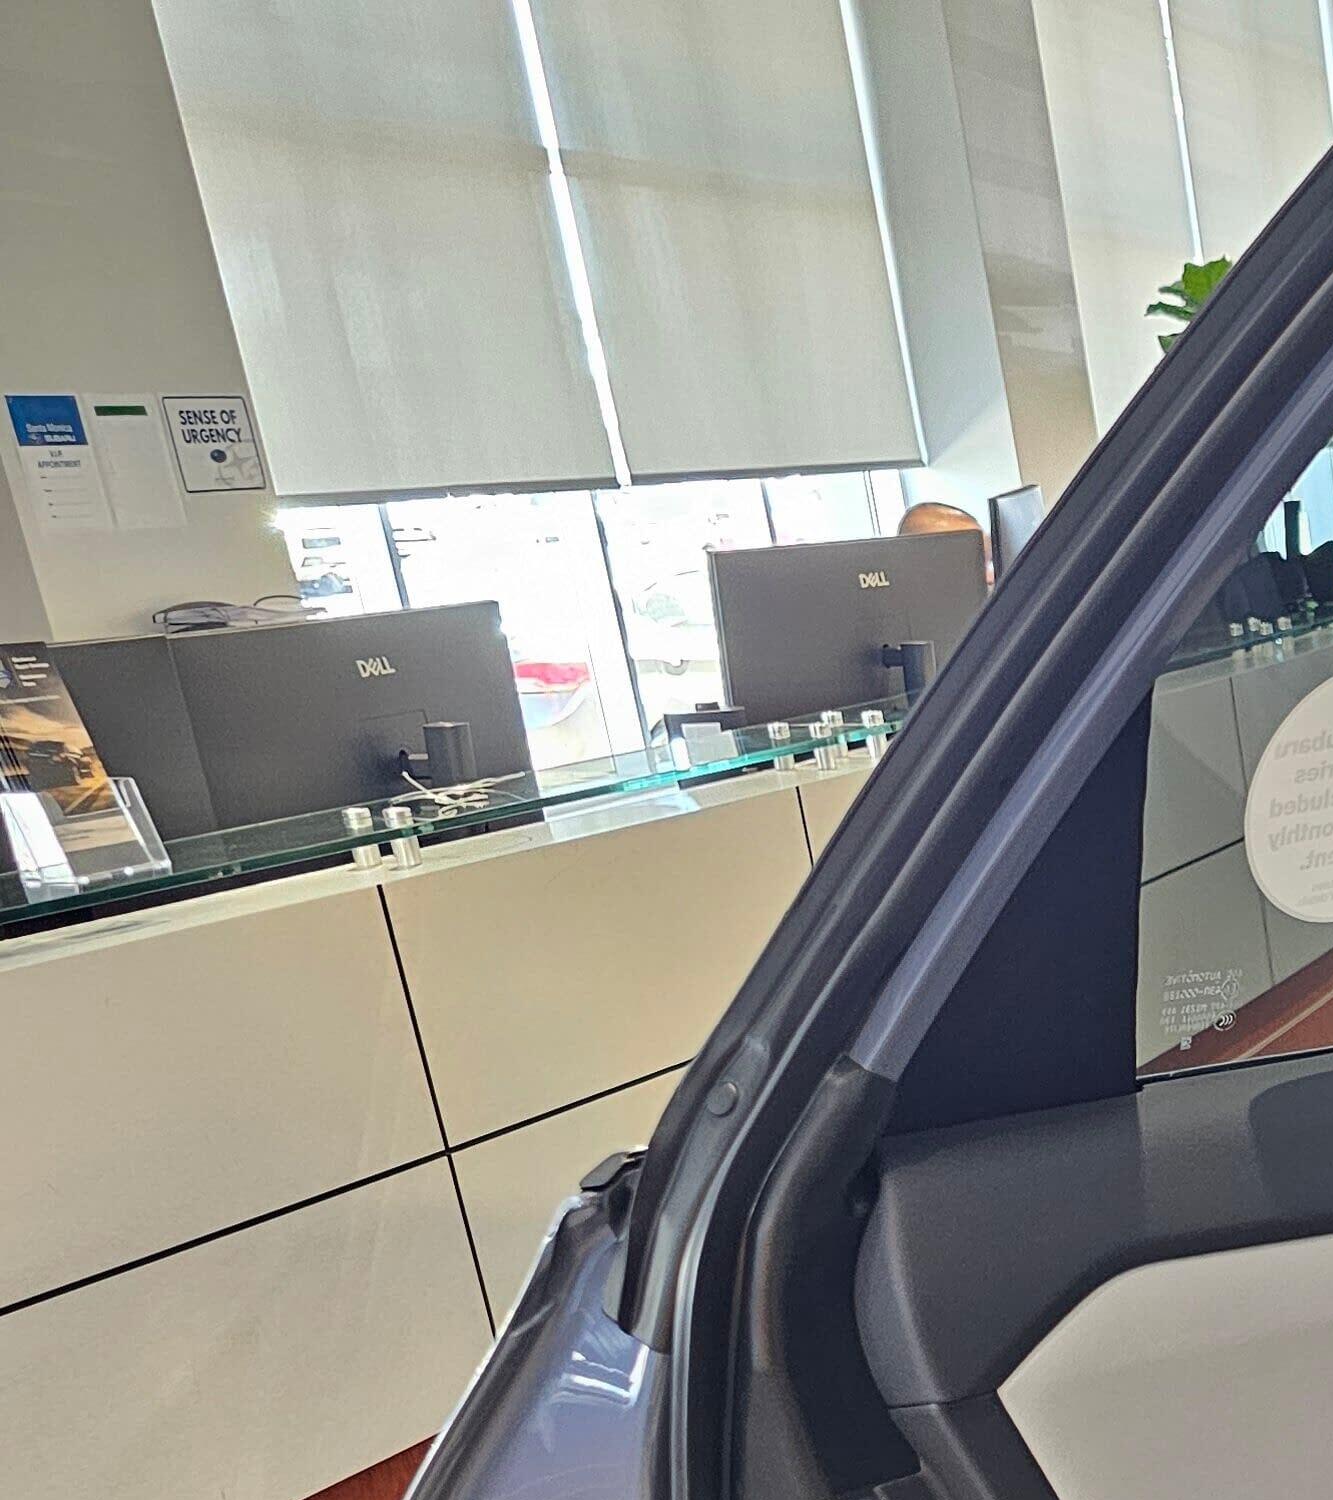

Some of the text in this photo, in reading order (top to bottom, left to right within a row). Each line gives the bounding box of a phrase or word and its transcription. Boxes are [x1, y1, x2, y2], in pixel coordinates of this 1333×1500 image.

[178, 409, 238, 425] SENSE OF
[181, 427, 243, 443] URGENCY
[858, 570, 890, 589] DELL
[355, 656, 395, 679] DELL
